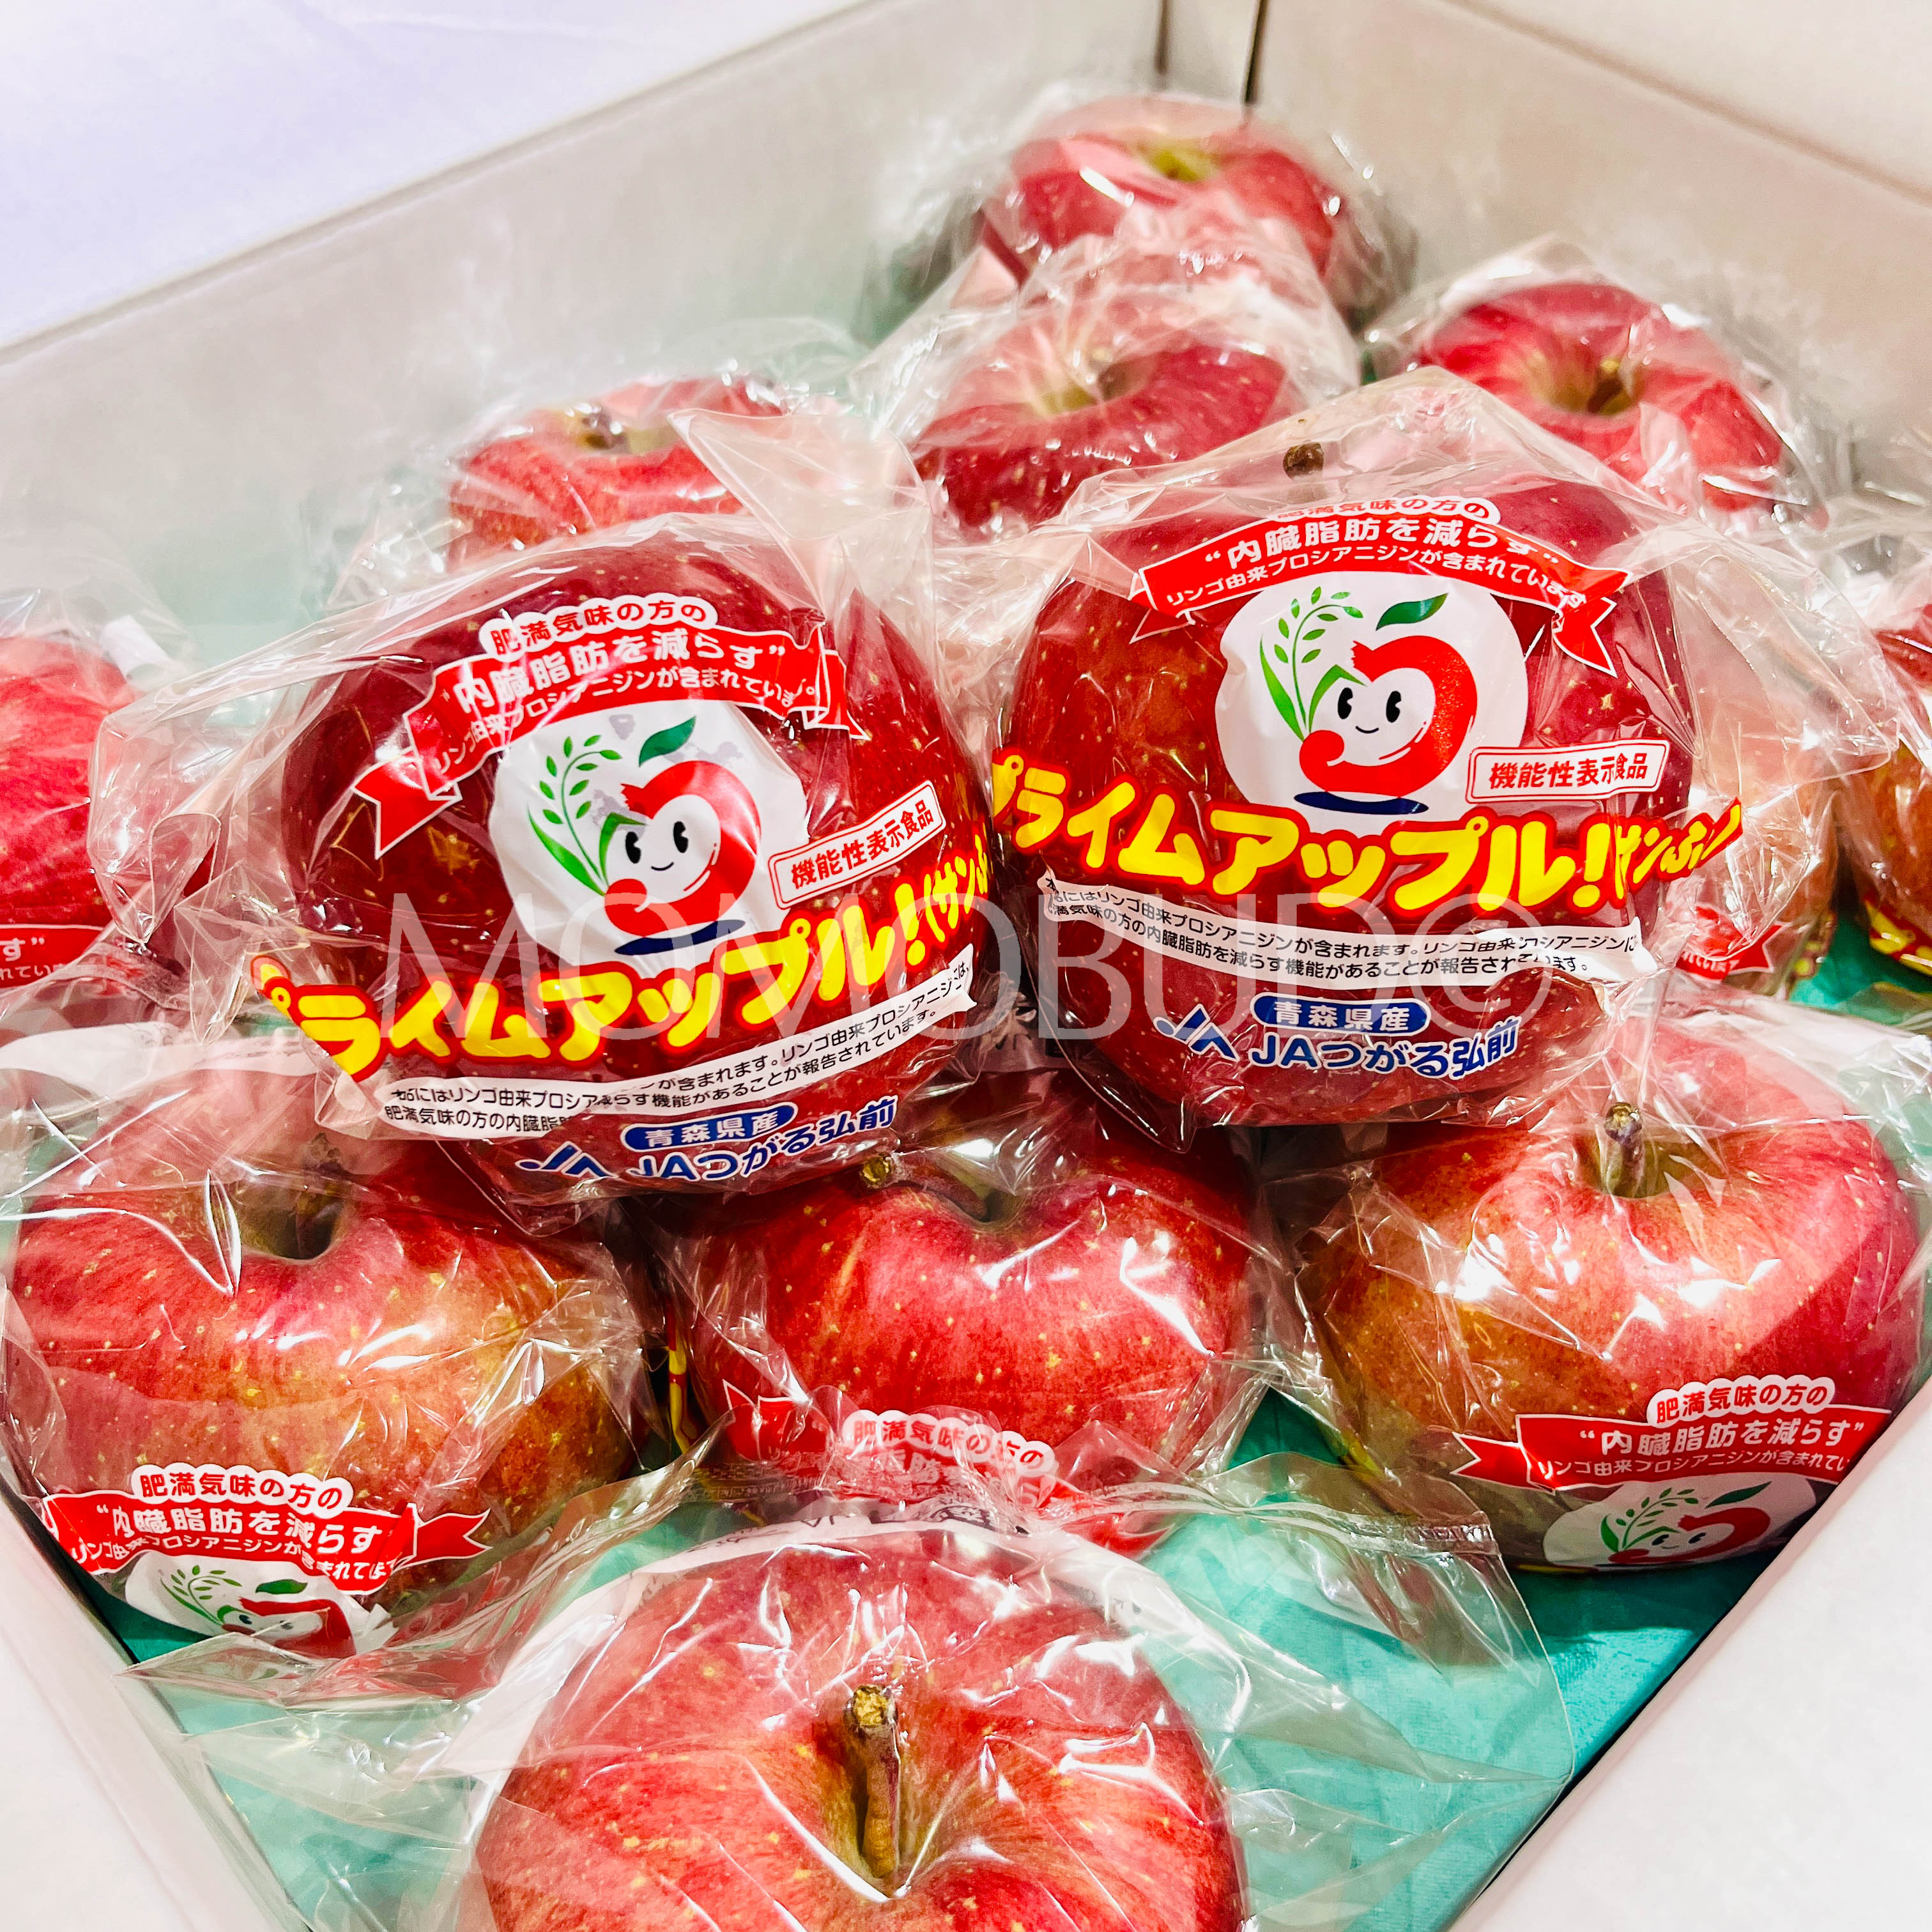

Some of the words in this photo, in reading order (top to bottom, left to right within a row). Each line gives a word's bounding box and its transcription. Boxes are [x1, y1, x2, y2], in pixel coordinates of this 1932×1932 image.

[490, 600, 708, 654] 肥満気味の方の
[436, 666, 815, 774] リンゴ由来プロシアニジンが含まれていま。
[1489, 752, 1648, 790] 機能性表示食品
[790, 799, 934, 890] 機能性表示食品
[0, 964, 66, 981] れてい
[1273, 1000, 1410, 1032] 青森県産
[1250, 1016, 1522, 1080] JAつがる弘前
[625, 1095, 898, 1181] JAつがる弘前
[644, 1111, 780, 1147] 青森県産
[1656, 1383, 1828, 1425] 肥満気味の方の
[140, 1472, 344, 1510] 肥満気味の方の
